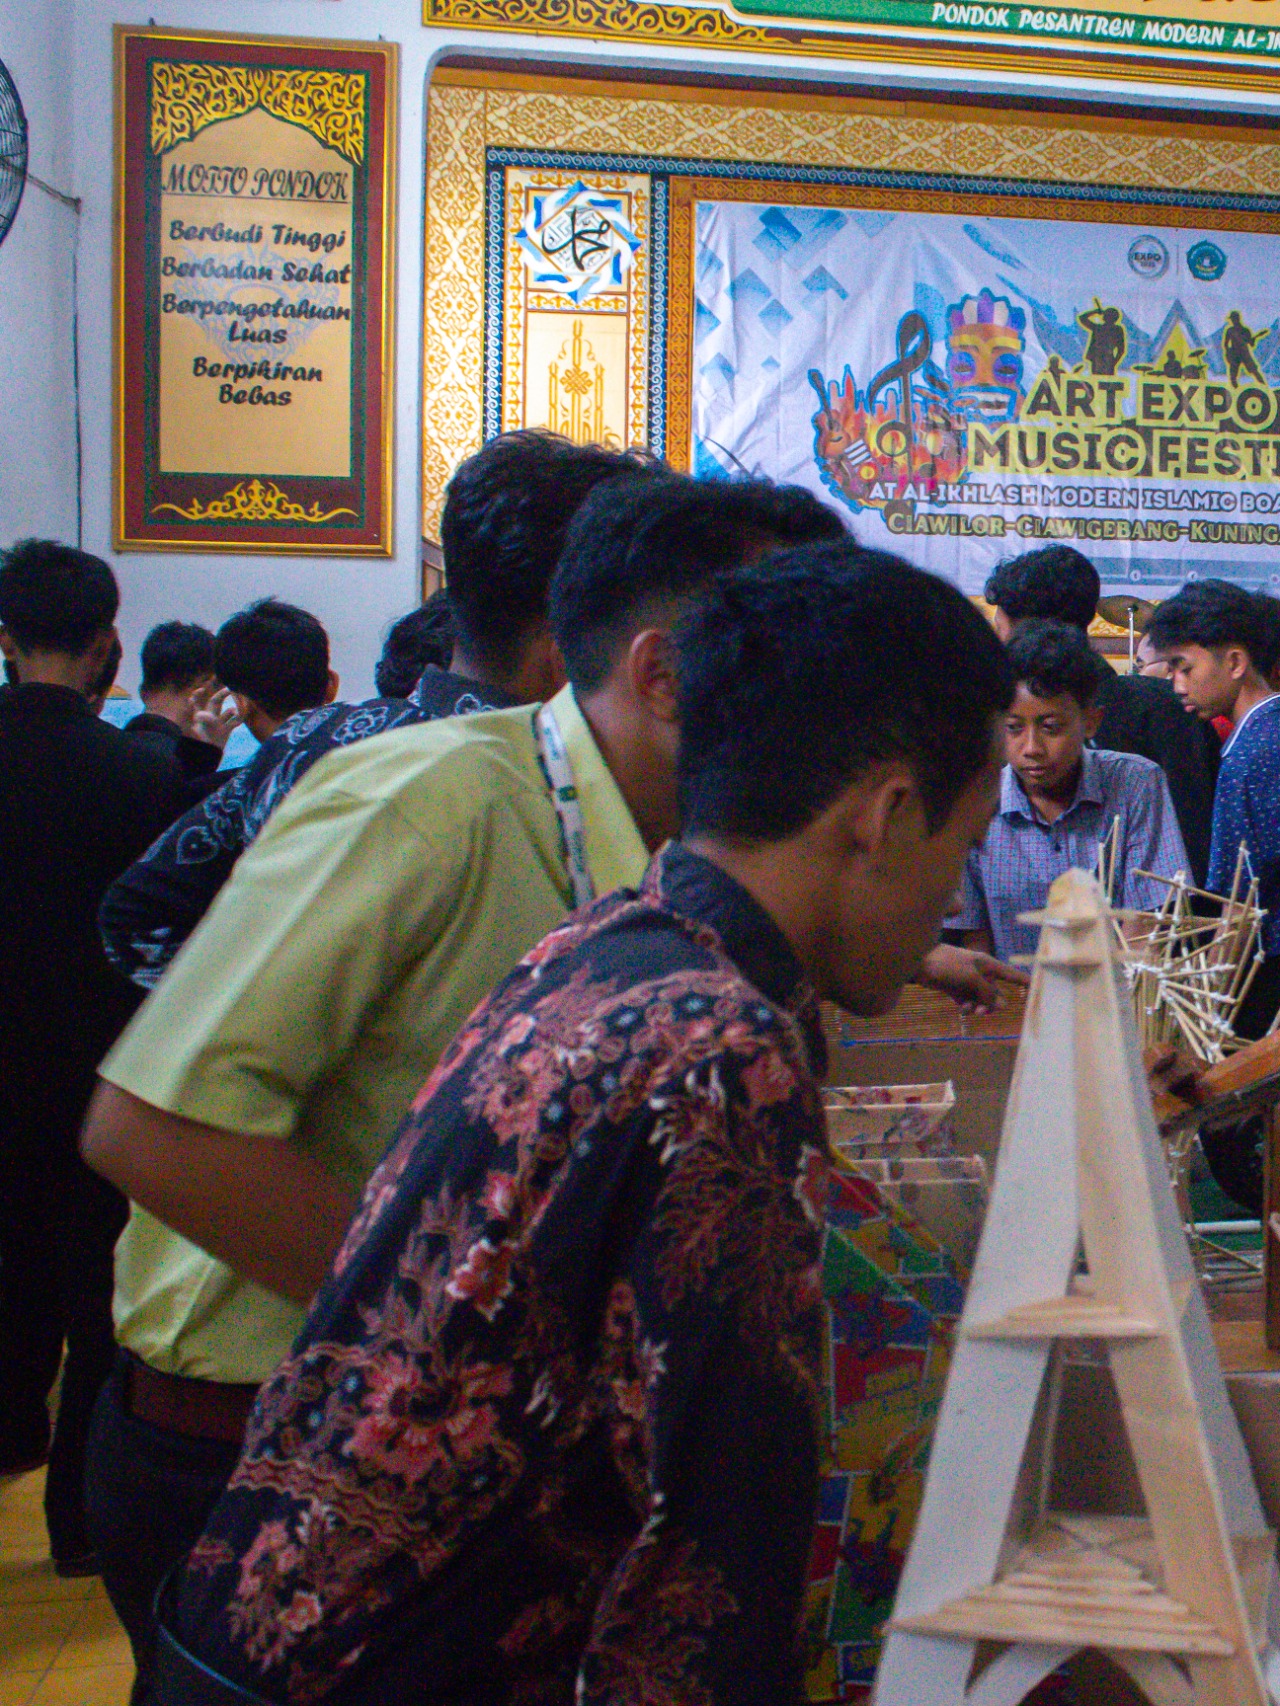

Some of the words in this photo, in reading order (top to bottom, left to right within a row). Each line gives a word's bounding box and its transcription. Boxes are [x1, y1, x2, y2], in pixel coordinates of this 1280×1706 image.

[931, 3, 1011, 30] PONDOK
[1017, 10, 1135, 38] PESANTREN
[1141, 21, 1224, 47] MODERN
[161, 164, 248, 195] MOTTO
[250, 168, 348, 199] PONDOK
[169, 220, 264, 243] Berbudi
[271, 224, 346, 253] Tinggi
[161, 256, 273, 281] Berbadan
[282, 261, 351, 283] Sehat
[1134, 251, 1162, 262] EXPO
[161, 293, 351, 323] Berpengetahuan
[228, 320, 288, 344] Luas
[192, 356, 323, 384] Berpikiran
[218, 383, 292, 406] Bebas
[1026, 378, 1124, 421] ART
[1141, 383, 1275, 428] EXPO
[973, 428, 1144, 475] MUSIC
[868, 482, 897, 501] AT
[902, 482, 1039, 505] AL-IKHLASH
[1043, 488, 1140, 508] MODERN
[1143, 490, 1236, 512] ISLAMIC
